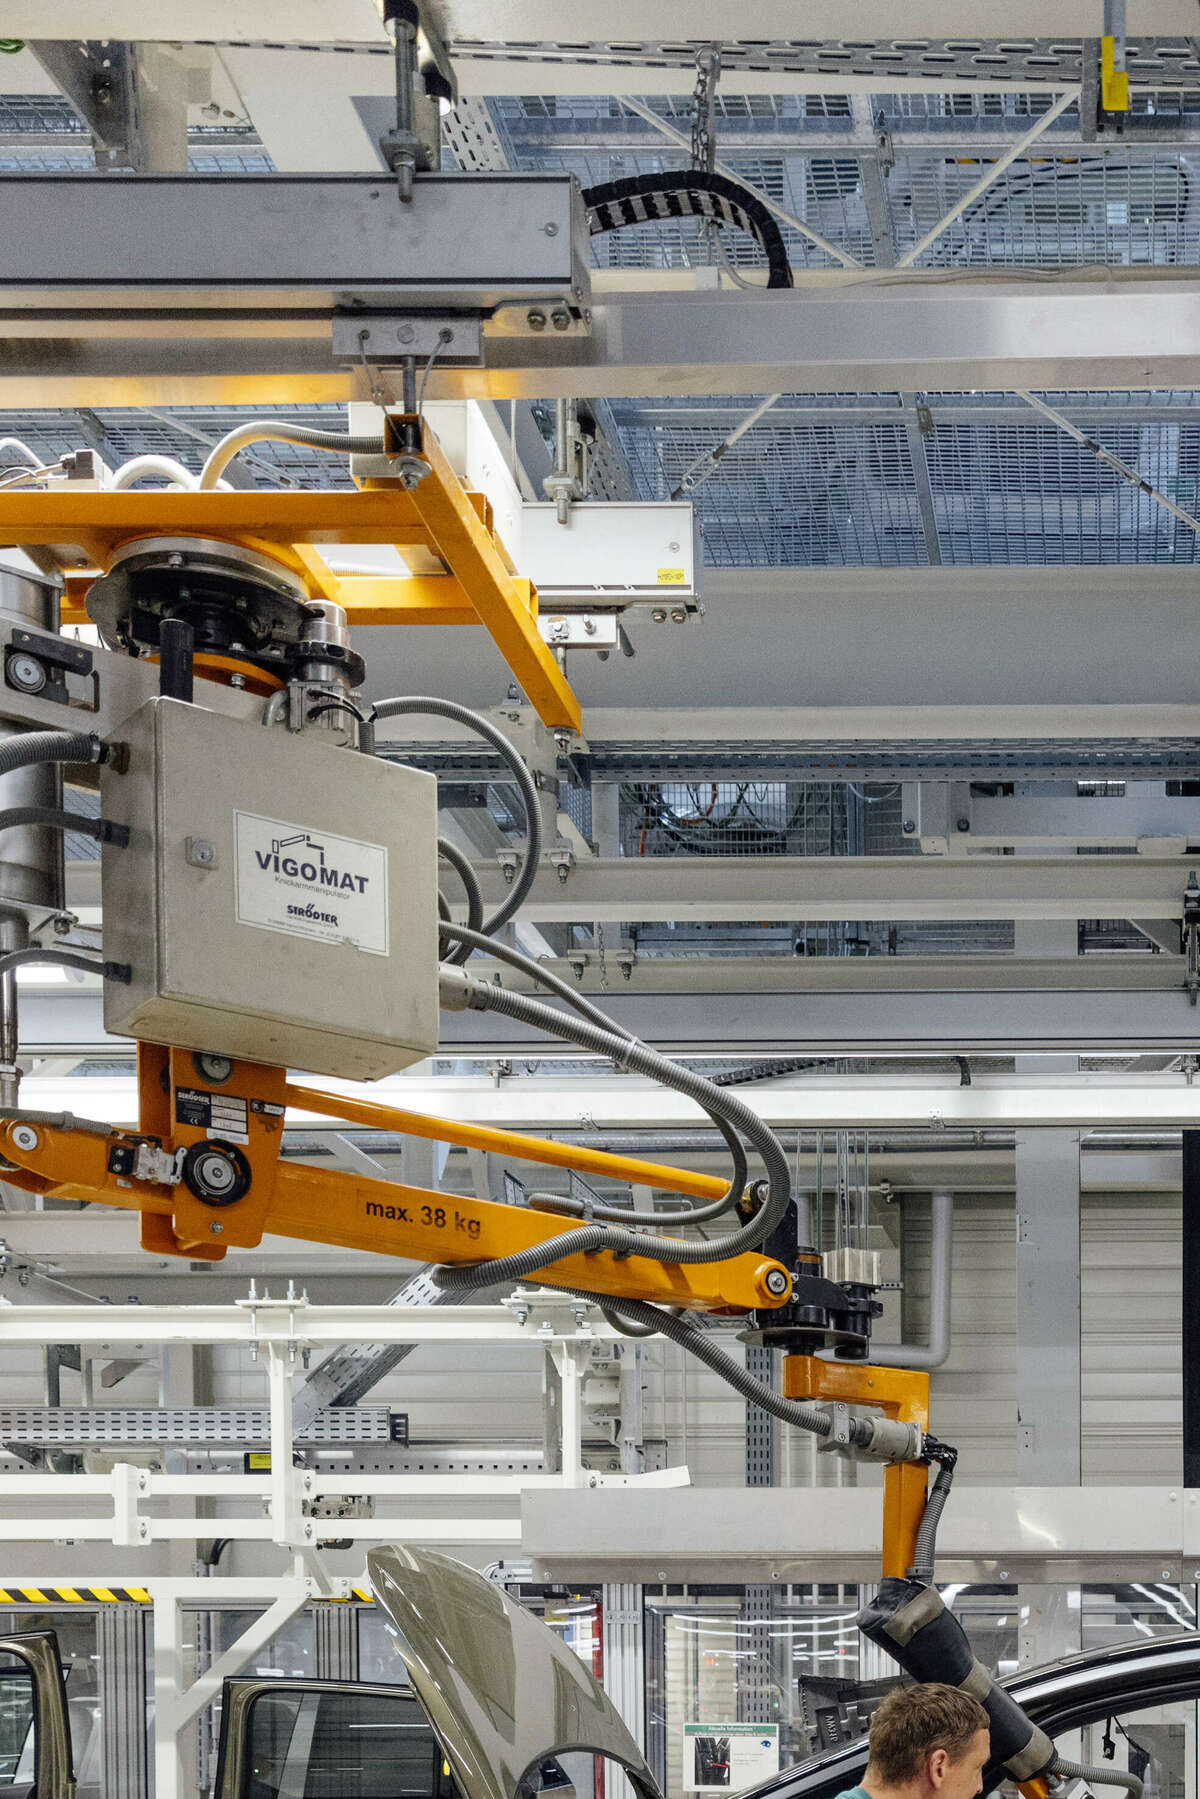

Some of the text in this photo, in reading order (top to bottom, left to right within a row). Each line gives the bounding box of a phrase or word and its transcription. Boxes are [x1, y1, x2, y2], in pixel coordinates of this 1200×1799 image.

[255, 850, 369, 893] VIGOMAT
[287, 903, 338, 927] STRÖDTER
[366, 1201, 481, 1240] max. 38 kg
